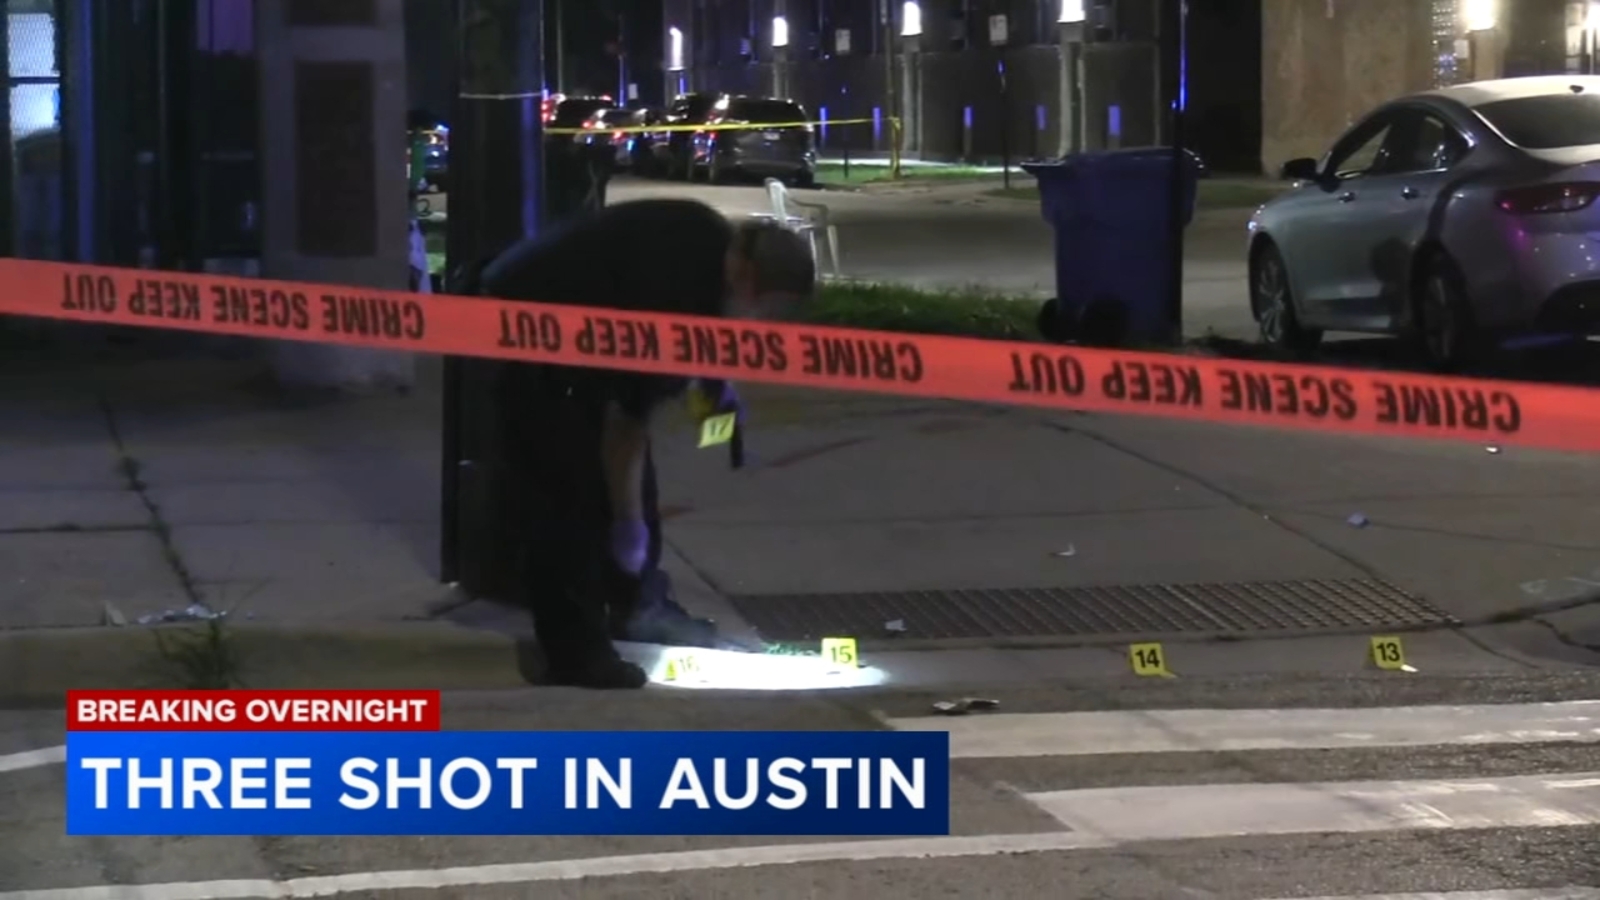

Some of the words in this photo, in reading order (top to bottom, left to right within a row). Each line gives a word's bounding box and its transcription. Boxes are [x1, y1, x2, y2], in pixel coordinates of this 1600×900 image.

[61, 273, 116, 313] OUT
[129, 279, 200, 320] KEEP
[211, 285, 309, 330] SCENE
[321, 294, 424, 339] CRIME
[498, 309, 561, 352] OUT
[575, 316, 660, 360] KEEP
[671, 323, 788, 371] SCENE
[800, 334, 923, 382] CRIME
[1009, 352, 1085, 396] OUT
[1102, 360, 1201, 408] KEEP
[1217, 369, 1357, 421] SCENE
[1376, 381, 1520, 433] CRIME
[829, 645, 853, 664] 15
[1135, 648, 1160, 668] 14
[1375, 642, 1400, 662] 13
